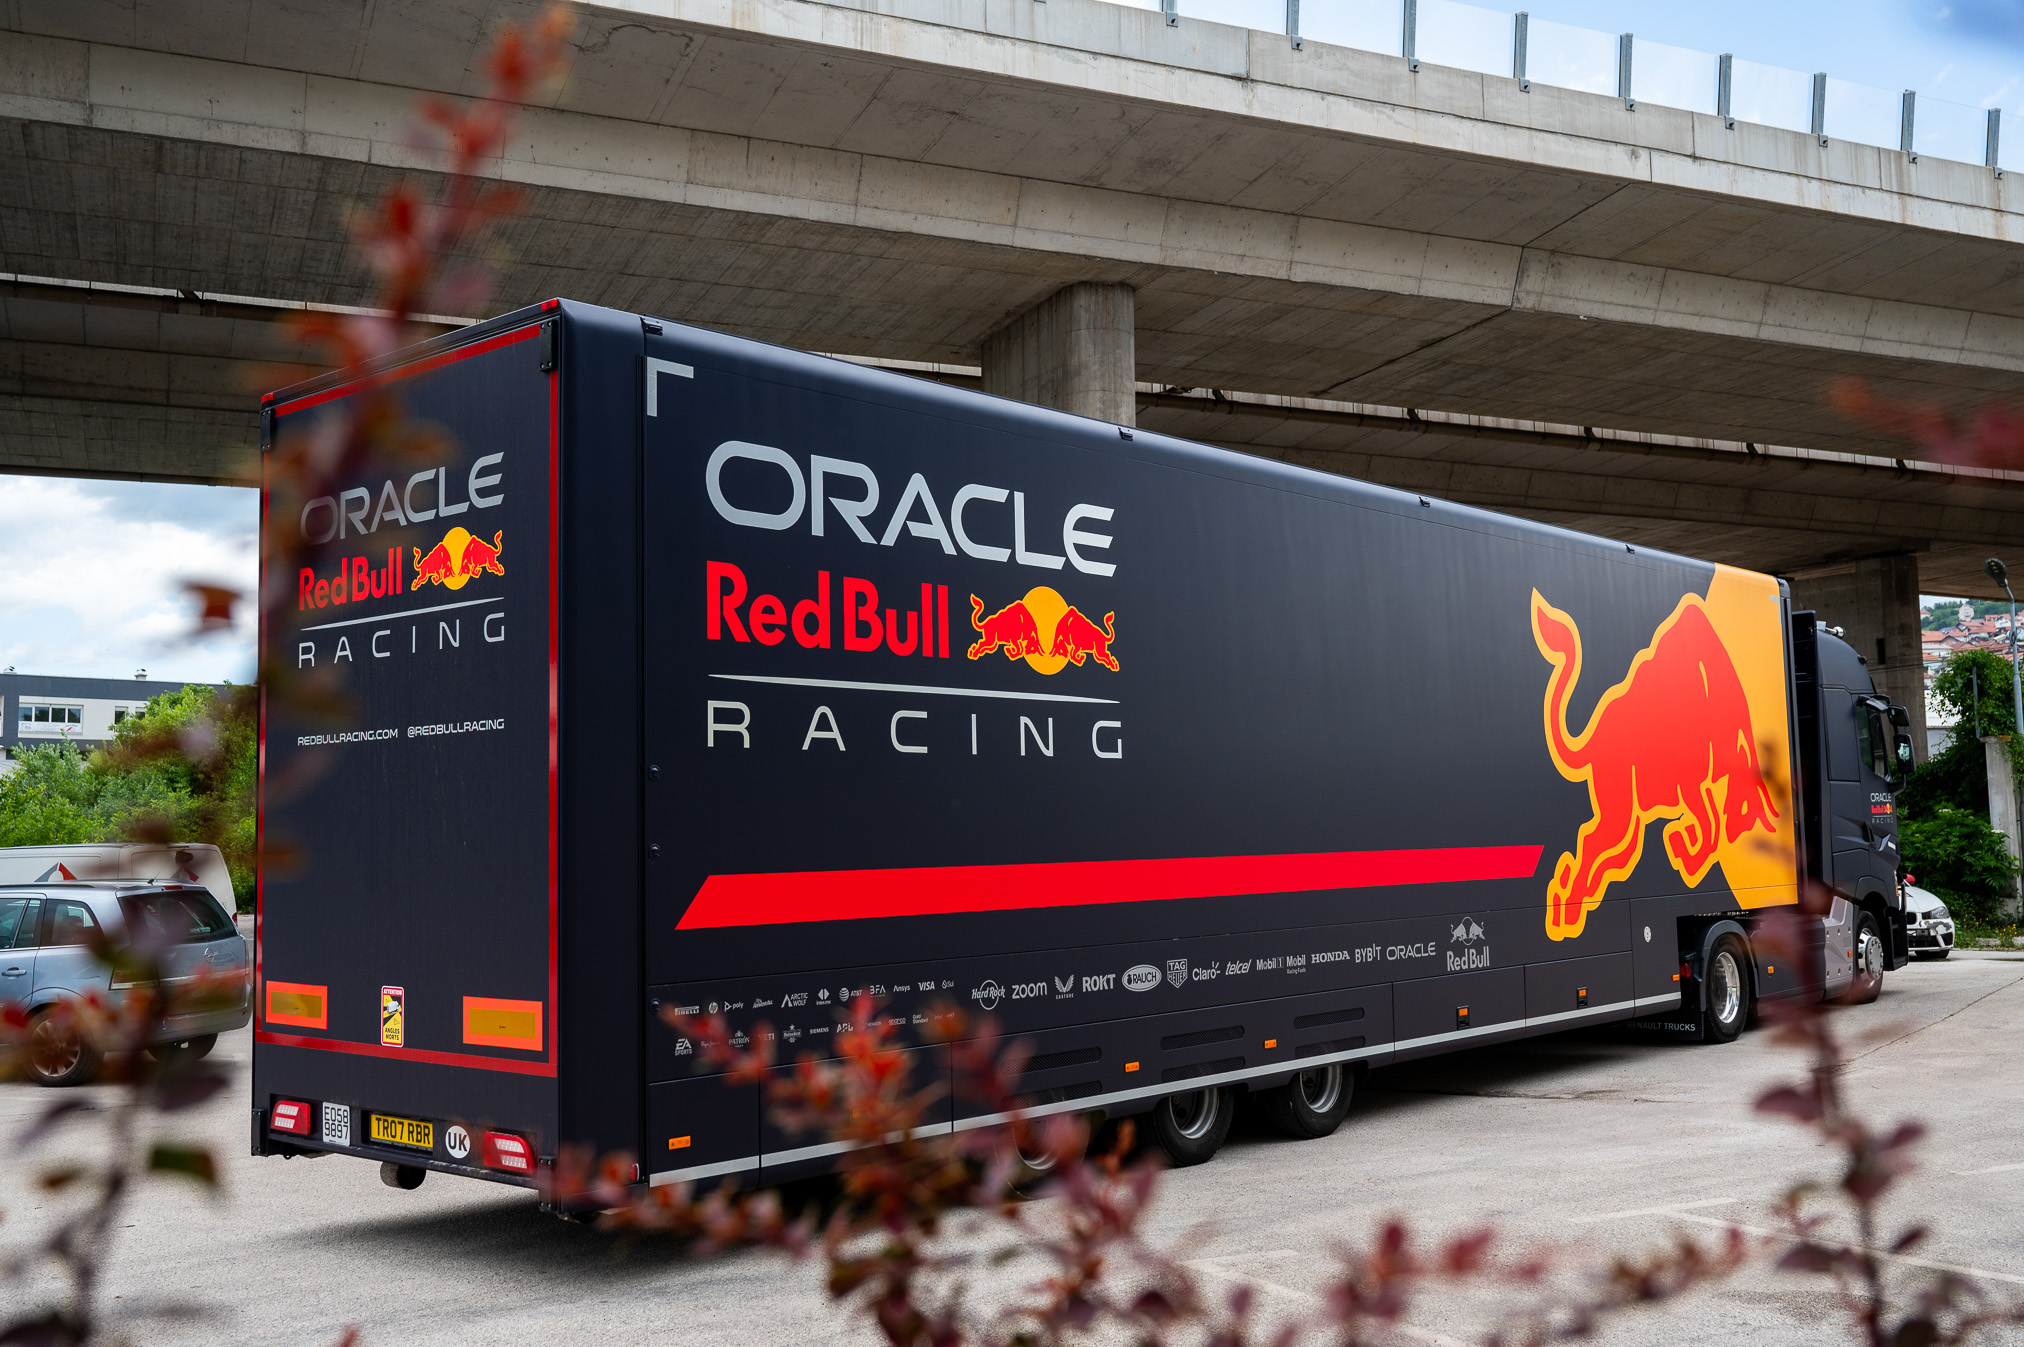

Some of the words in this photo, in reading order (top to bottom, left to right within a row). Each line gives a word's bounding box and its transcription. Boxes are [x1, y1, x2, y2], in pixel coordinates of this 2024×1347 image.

[300, 451, 505, 546] ORACLE
[706, 440, 1117, 577] ORACLE
[299, 557, 347, 611] Red
[351, 546, 403, 602] Bull
[706, 560, 831, 649] Red
[843, 576, 950, 659] Bull
[298, 612, 505, 669] RACING
[297, 728, 398, 746] REDBULLRACING.COM
[407, 718, 505, 738] @REDBULLRACING
[707, 700, 1123, 759] RACING
[1870, 792, 1892, 802] ORACLE
[1310, 950, 1351, 964] HONDA
[1354, 943, 1382, 963] BYBIT
[1386, 941, 1437, 961] ORACLE
[1256, 957, 1277, 971] Mobil
[1286, 954, 1306, 967] Mobil
[1446, 948, 1469, 972] Red
[1469, 945, 1490, 969] Bull
[1168, 961, 1186, 971] TAG
[1225, 959, 1252, 976] telcel
[1132, 971, 1157, 984] RAUCH
[1168, 971, 1187, 986] HEUER
[1192, 966, 1217, 981] Claro
[893, 984, 911, 993] Ansys
[918, 981, 936, 991] VISA
[1011, 981, 1048, 1000] zoom
[1082, 974, 1116, 993] ROKT
[790, 992, 809, 1000] ARCTIC
[850, 989, 862, 997] AT&T
[971, 987, 989, 1000] Hard
[988, 985, 1006, 1000] Rock
[732, 1001, 744, 1010] poly
[792, 999, 807, 1007] WOLF
[674, 1005, 700, 1016] PIRELLI
[385, 1027, 400, 1035] ANGLES
[809, 1027, 829, 1035] SIEMENS
[1627, 1021, 1662, 1030] RENAULT
[1664, 1022, 1696, 1032] TRUCKS
[385, 1033, 400, 1041] MORTS
[728, 1035, 750, 1046] PATRÓN
[675, 1038, 692, 1051] EA
[674, 1048, 693, 1056] SPORTS
[324, 1122, 349, 1140] 9897
[407, 1122, 431, 1145] RBR
[447, 1132, 468, 1152] UK
